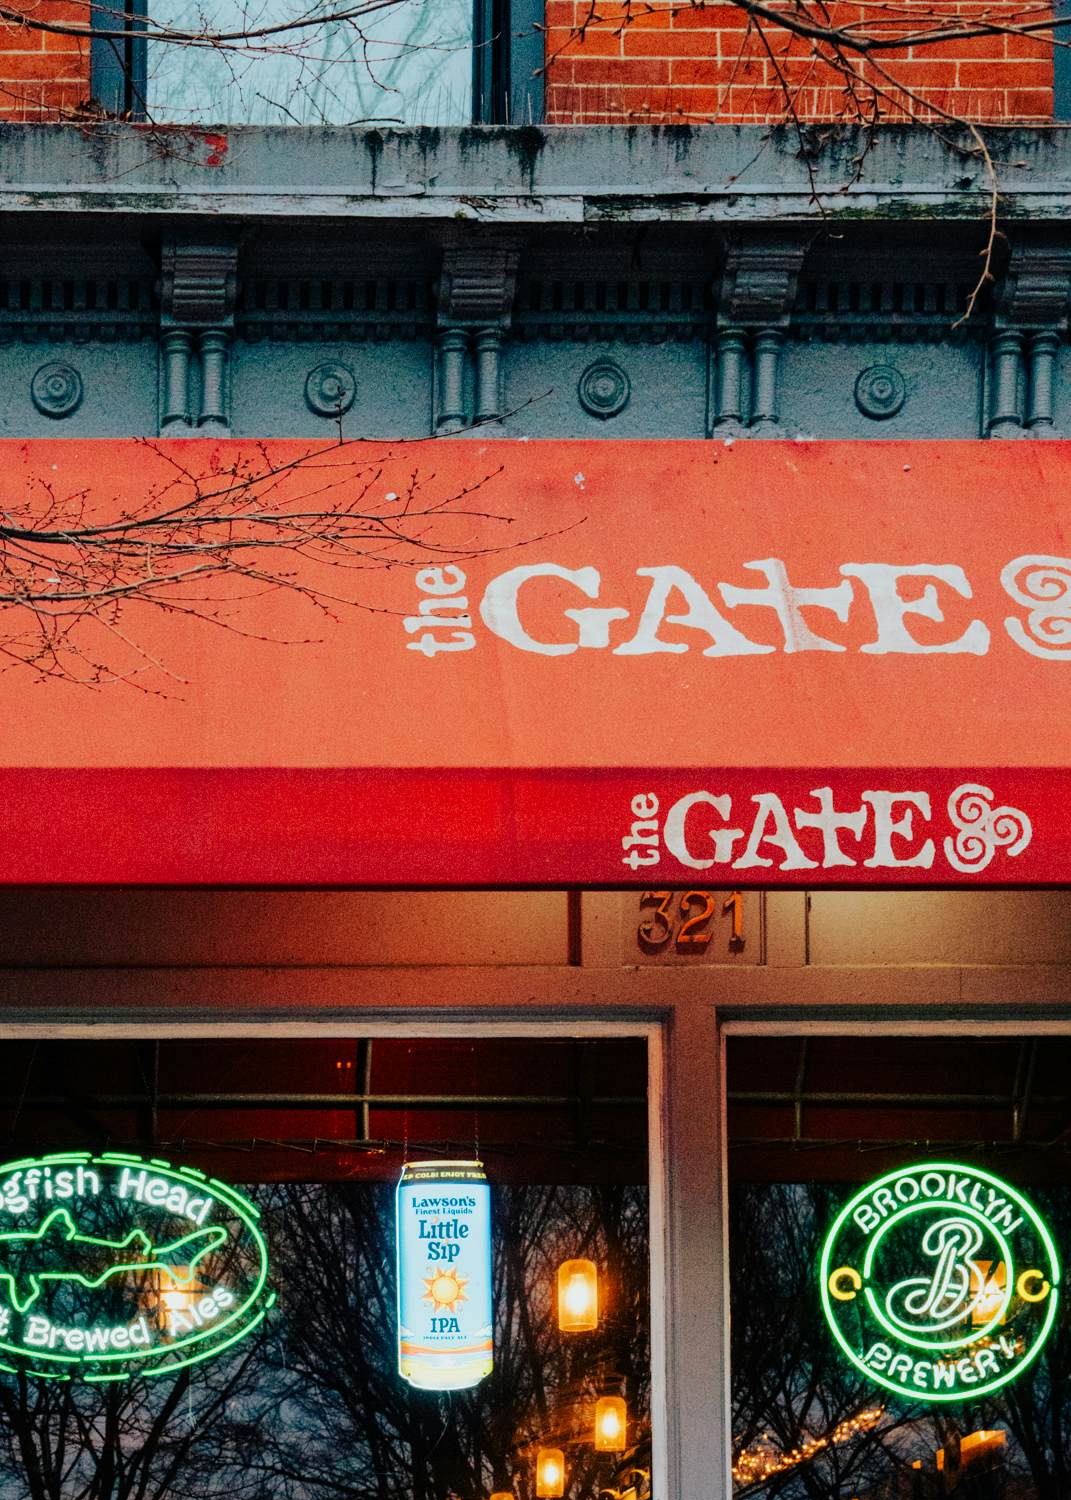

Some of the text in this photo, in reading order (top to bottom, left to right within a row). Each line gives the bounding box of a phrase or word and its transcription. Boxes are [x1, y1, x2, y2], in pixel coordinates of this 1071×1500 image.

[403, 565, 473, 657] the
[621, 792, 660, 870] the
[639, 890, 745, 950] 321
[119, 1167, 214, 1225] Head
[412, 1196, 476, 1207] Lawson's
[415, 1207, 473, 1217] Finest Liquids
[853, 1172, 1024, 1236] BROOKLYN
[418, 1217, 469, 1240] Little
[427, 1240, 461, 1263] Sip
[23, 1315, 151, 1353] Brewed
[167, 1285, 235, 1338] Ales
[430, 1317, 461, 1333] IPA
[864, 1335, 1016, 1389] BREWERY
